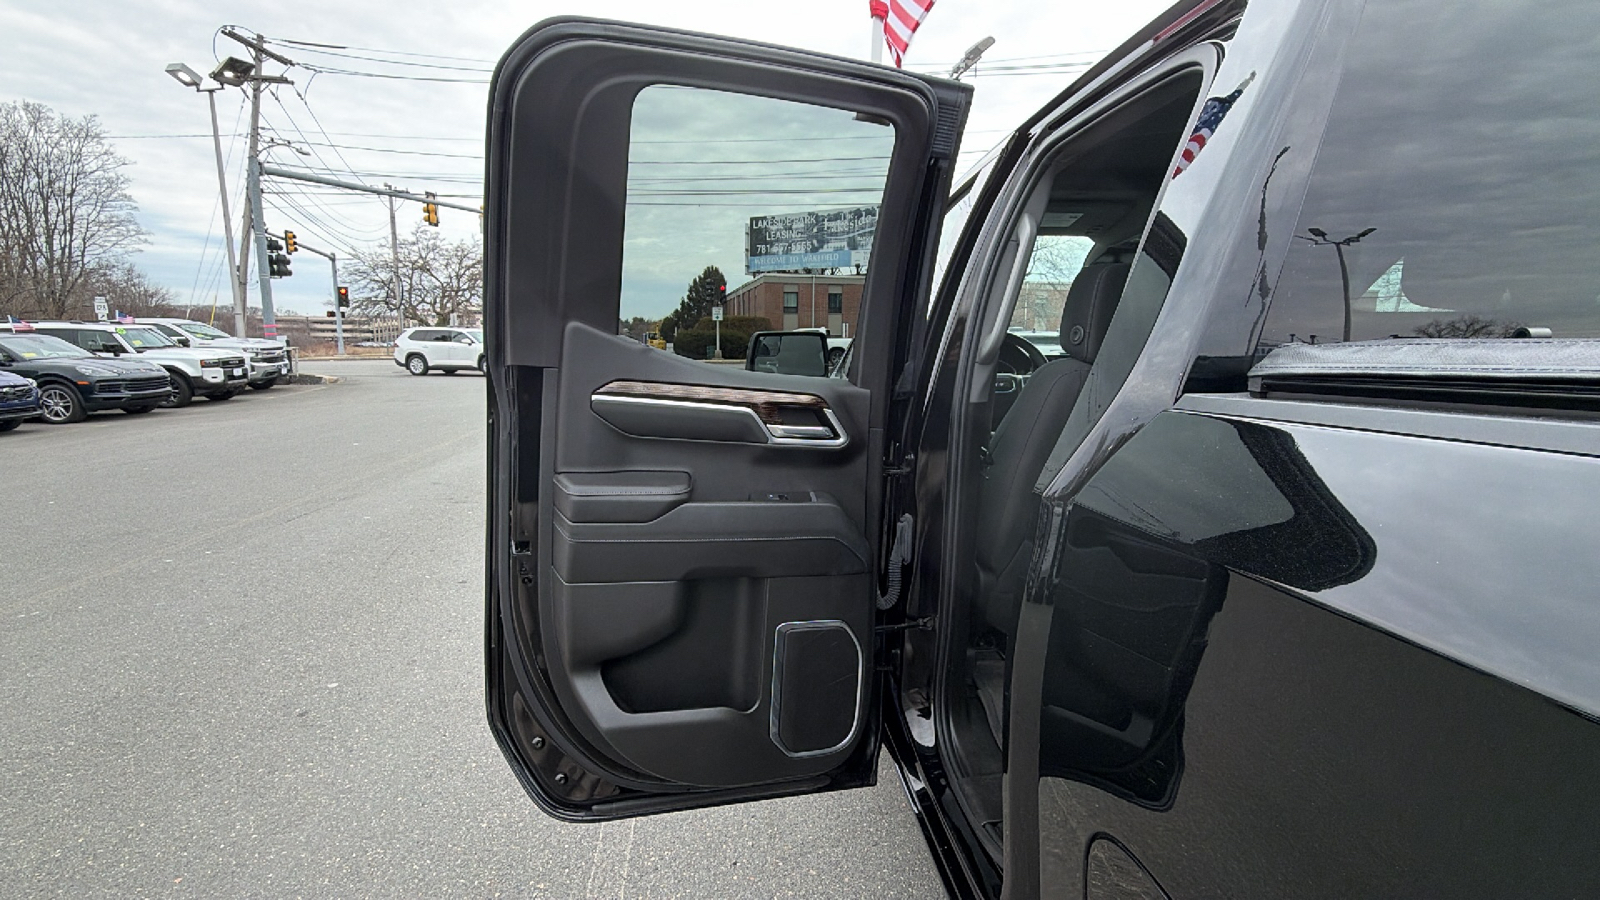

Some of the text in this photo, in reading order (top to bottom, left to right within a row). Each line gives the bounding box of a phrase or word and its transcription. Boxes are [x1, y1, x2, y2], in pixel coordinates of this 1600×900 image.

[753, 214, 817, 229] LAKESIDE PARK
[766, 229, 802, 241] LEASING
[754, 253, 839, 265] WELCOME TO WAKEFIELD
